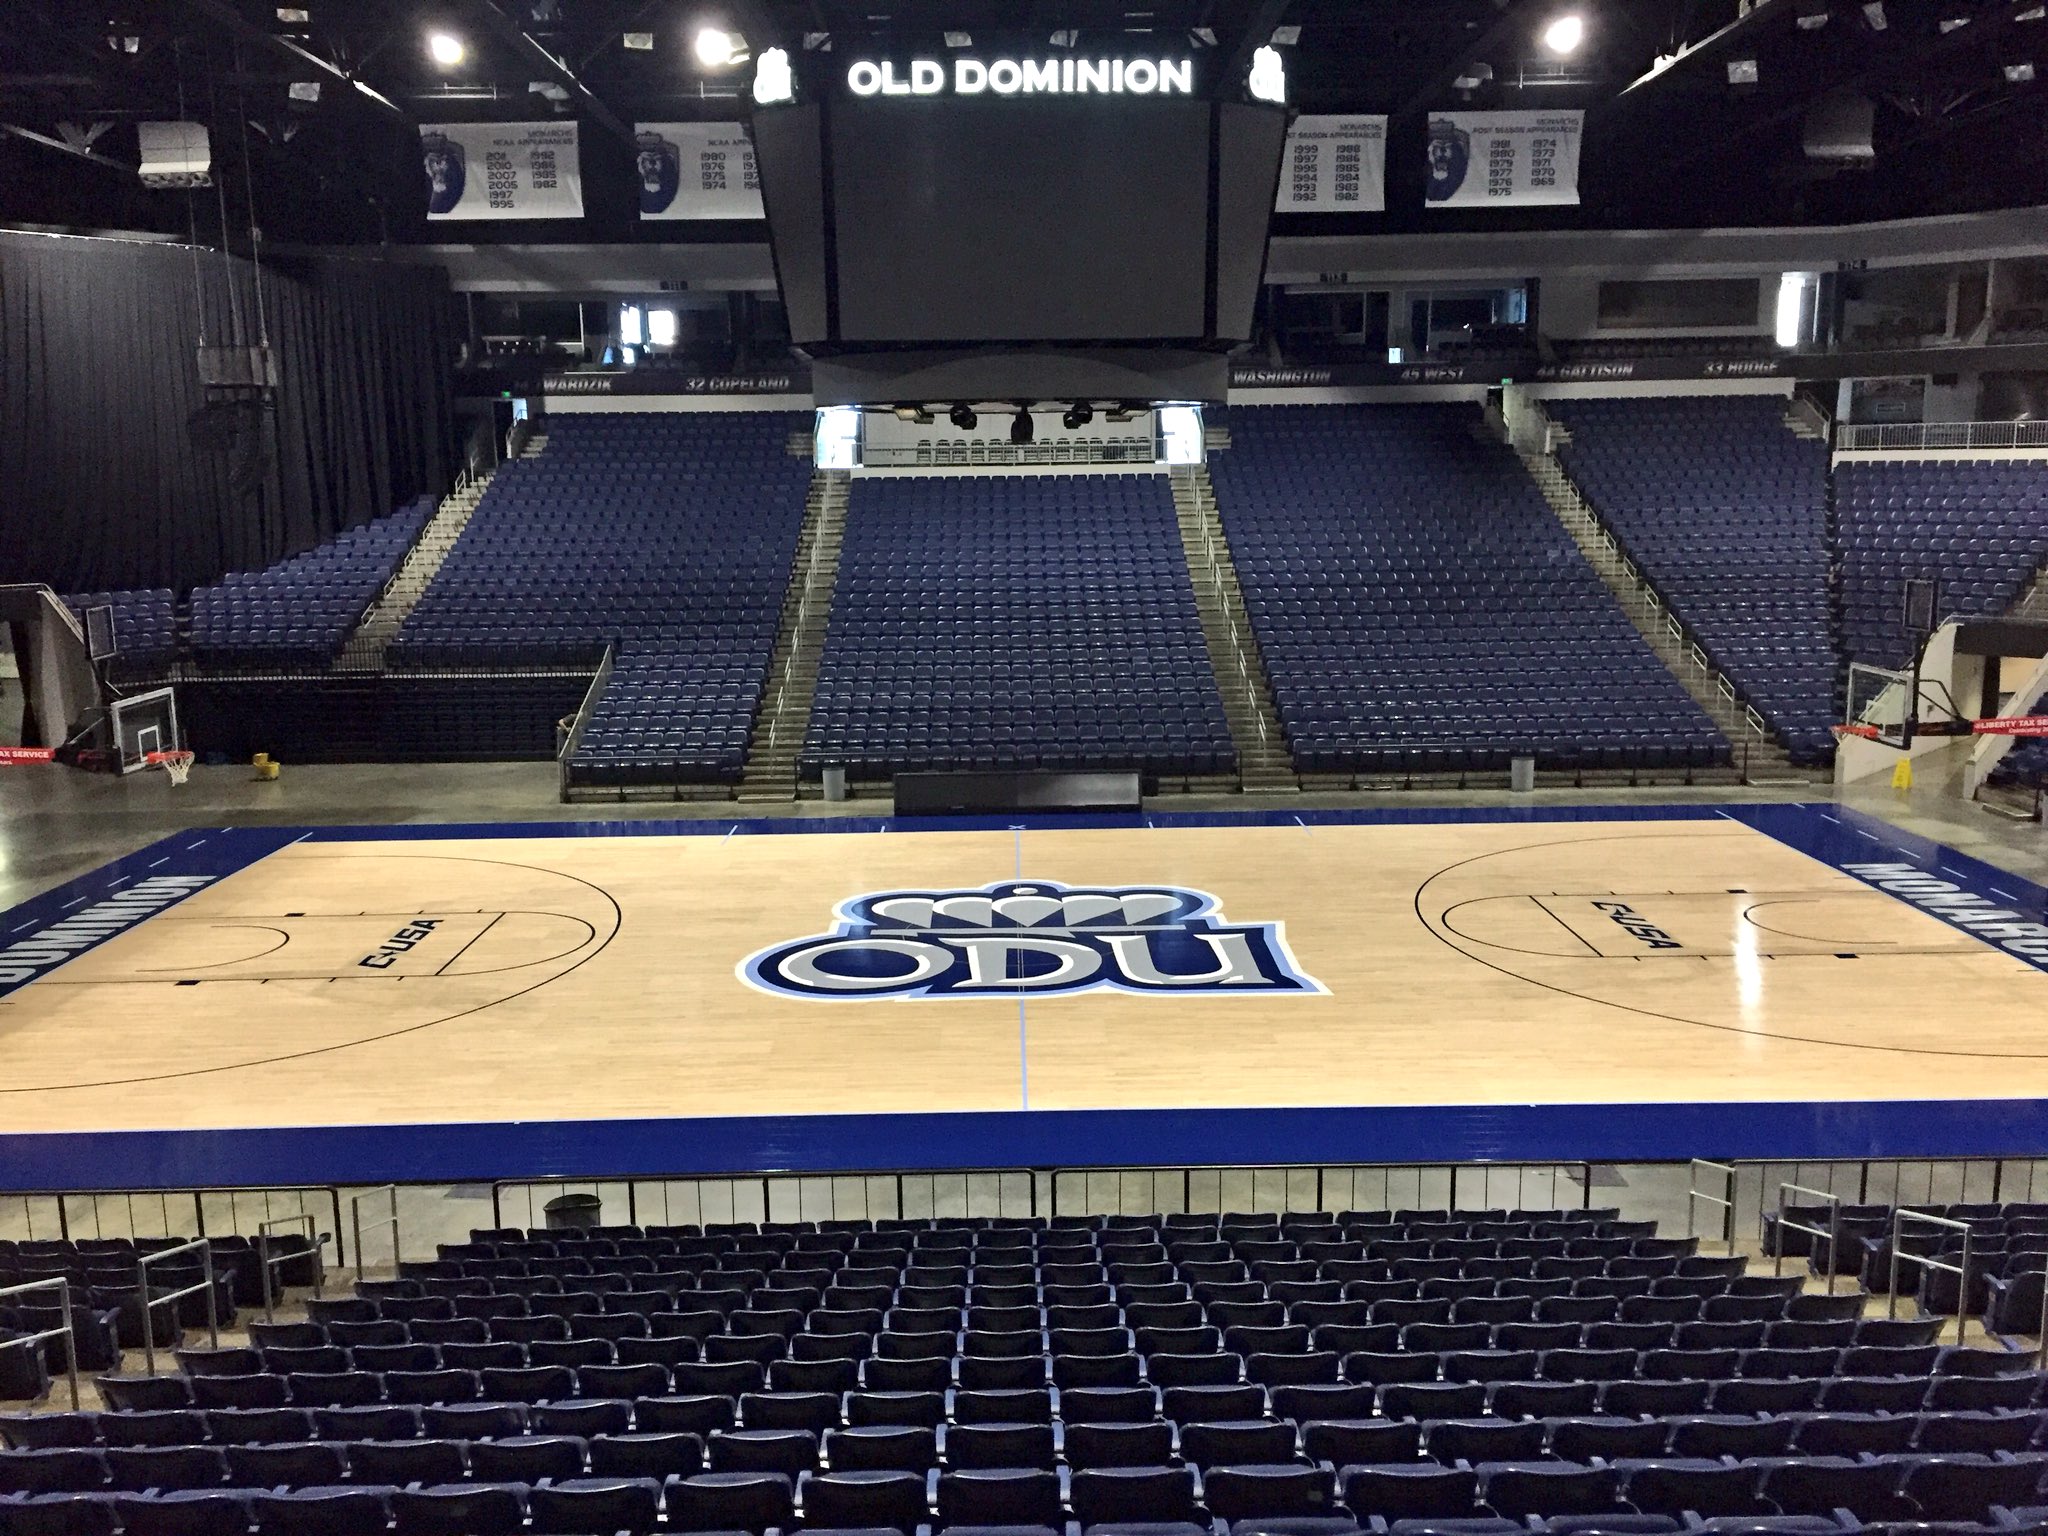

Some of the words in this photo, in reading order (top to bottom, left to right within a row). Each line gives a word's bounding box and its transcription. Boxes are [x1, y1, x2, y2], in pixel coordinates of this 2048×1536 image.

[848, 60, 944, 95] OLD
[954, 59, 1192, 93] DOMINION
[1532, 139, 1557, 148] 1974
[1294, 145, 1318, 154] 1999
[1532, 149, 1556, 157] 1973
[701, 152, 726, 161] 1980
[1294, 155, 1318, 163] 1997
[487, 161, 512, 170] 2010
[701, 162, 725, 170] 1976
[1489, 159, 1514, 168] 1979
[1531, 159, 1551, 167] 1971
[1294, 164, 1318, 173] 1995
[1335, 164, 1360, 173] 1985
[1489, 169, 1512, 177] 1977
[1531, 168, 1556, 177] 1970
[488, 171, 517, 180] 2007
[702, 171, 726, 180] 1975
[1293, 174, 1317, 182] 1994
[1335, 173, 1360, 182] 1984
[488, 181, 518, 190] 2005
[532, 180, 558, 189] 1982
[702, 181, 727, 190] 1974
[1488, 178, 1513, 187] 1976
[1293, 183, 1316, 192] 1993
[1488, 187, 1512, 196] 1975
[489, 190, 513, 199] 1997
[1293, 193, 1317, 201] 1992
[1335, 192, 1359, 201] 1982
[489, 200, 515, 209] 1995
[1704, 361, 1723, 375] 33
[1233, 370, 1332, 384] WASHINGTON
[1401, 369, 1421, 381] 45
[1425, 368, 1466, 381] WEST
[686, 378, 706, 391] 32
[709, 377, 790, 391] COPELAND
[1981, 720, 2017, 729] LIBERTY
[2019, 719, 2035, 727] TAX
[1839, 863, 2048, 964] MONARC
[777, 933, 1276, 989] ODU
